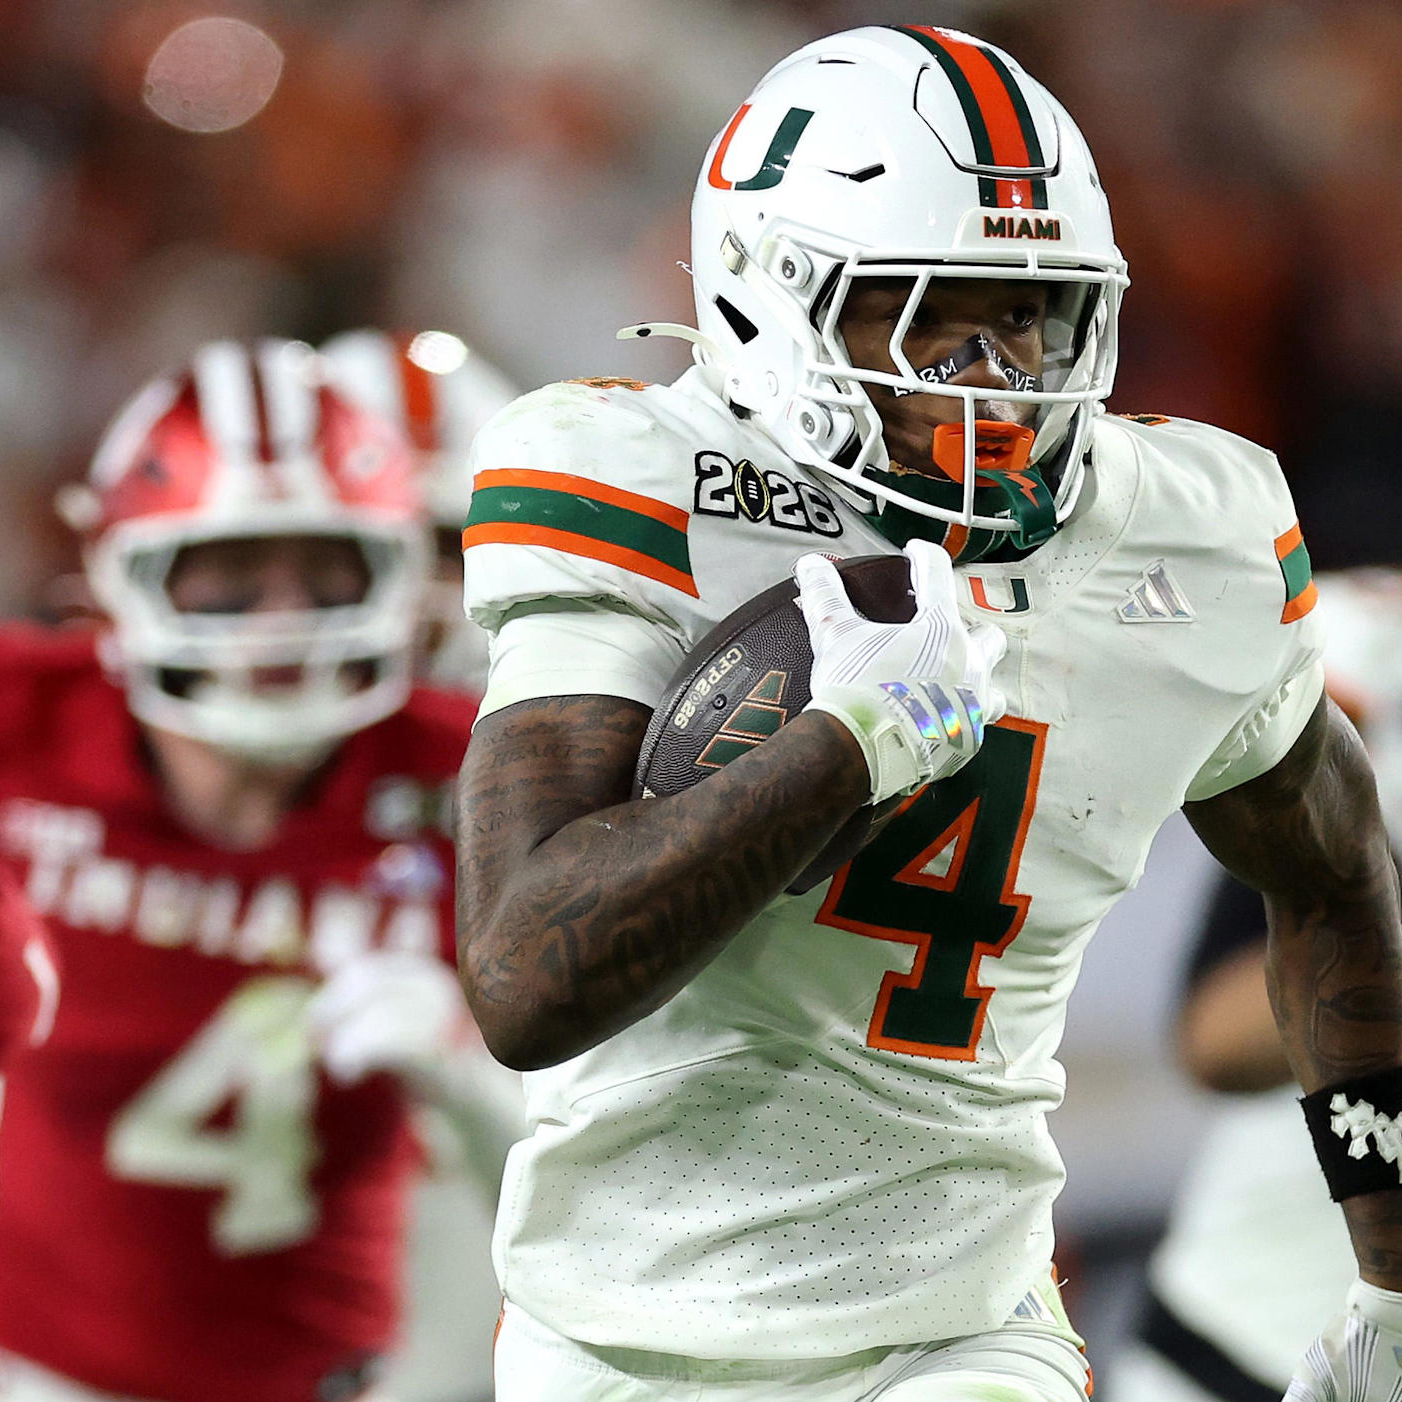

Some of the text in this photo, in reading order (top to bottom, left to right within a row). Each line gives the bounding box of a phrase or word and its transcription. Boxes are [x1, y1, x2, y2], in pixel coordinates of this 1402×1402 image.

[706, 104, 815, 191] U
[983, 215, 1061, 241] MIAMI
[694, 450, 844, 539] 2026
[966, 574, 1032, 615] U
[815, 715, 1048, 1062] 4
[108, 978, 322, 1253] 4
